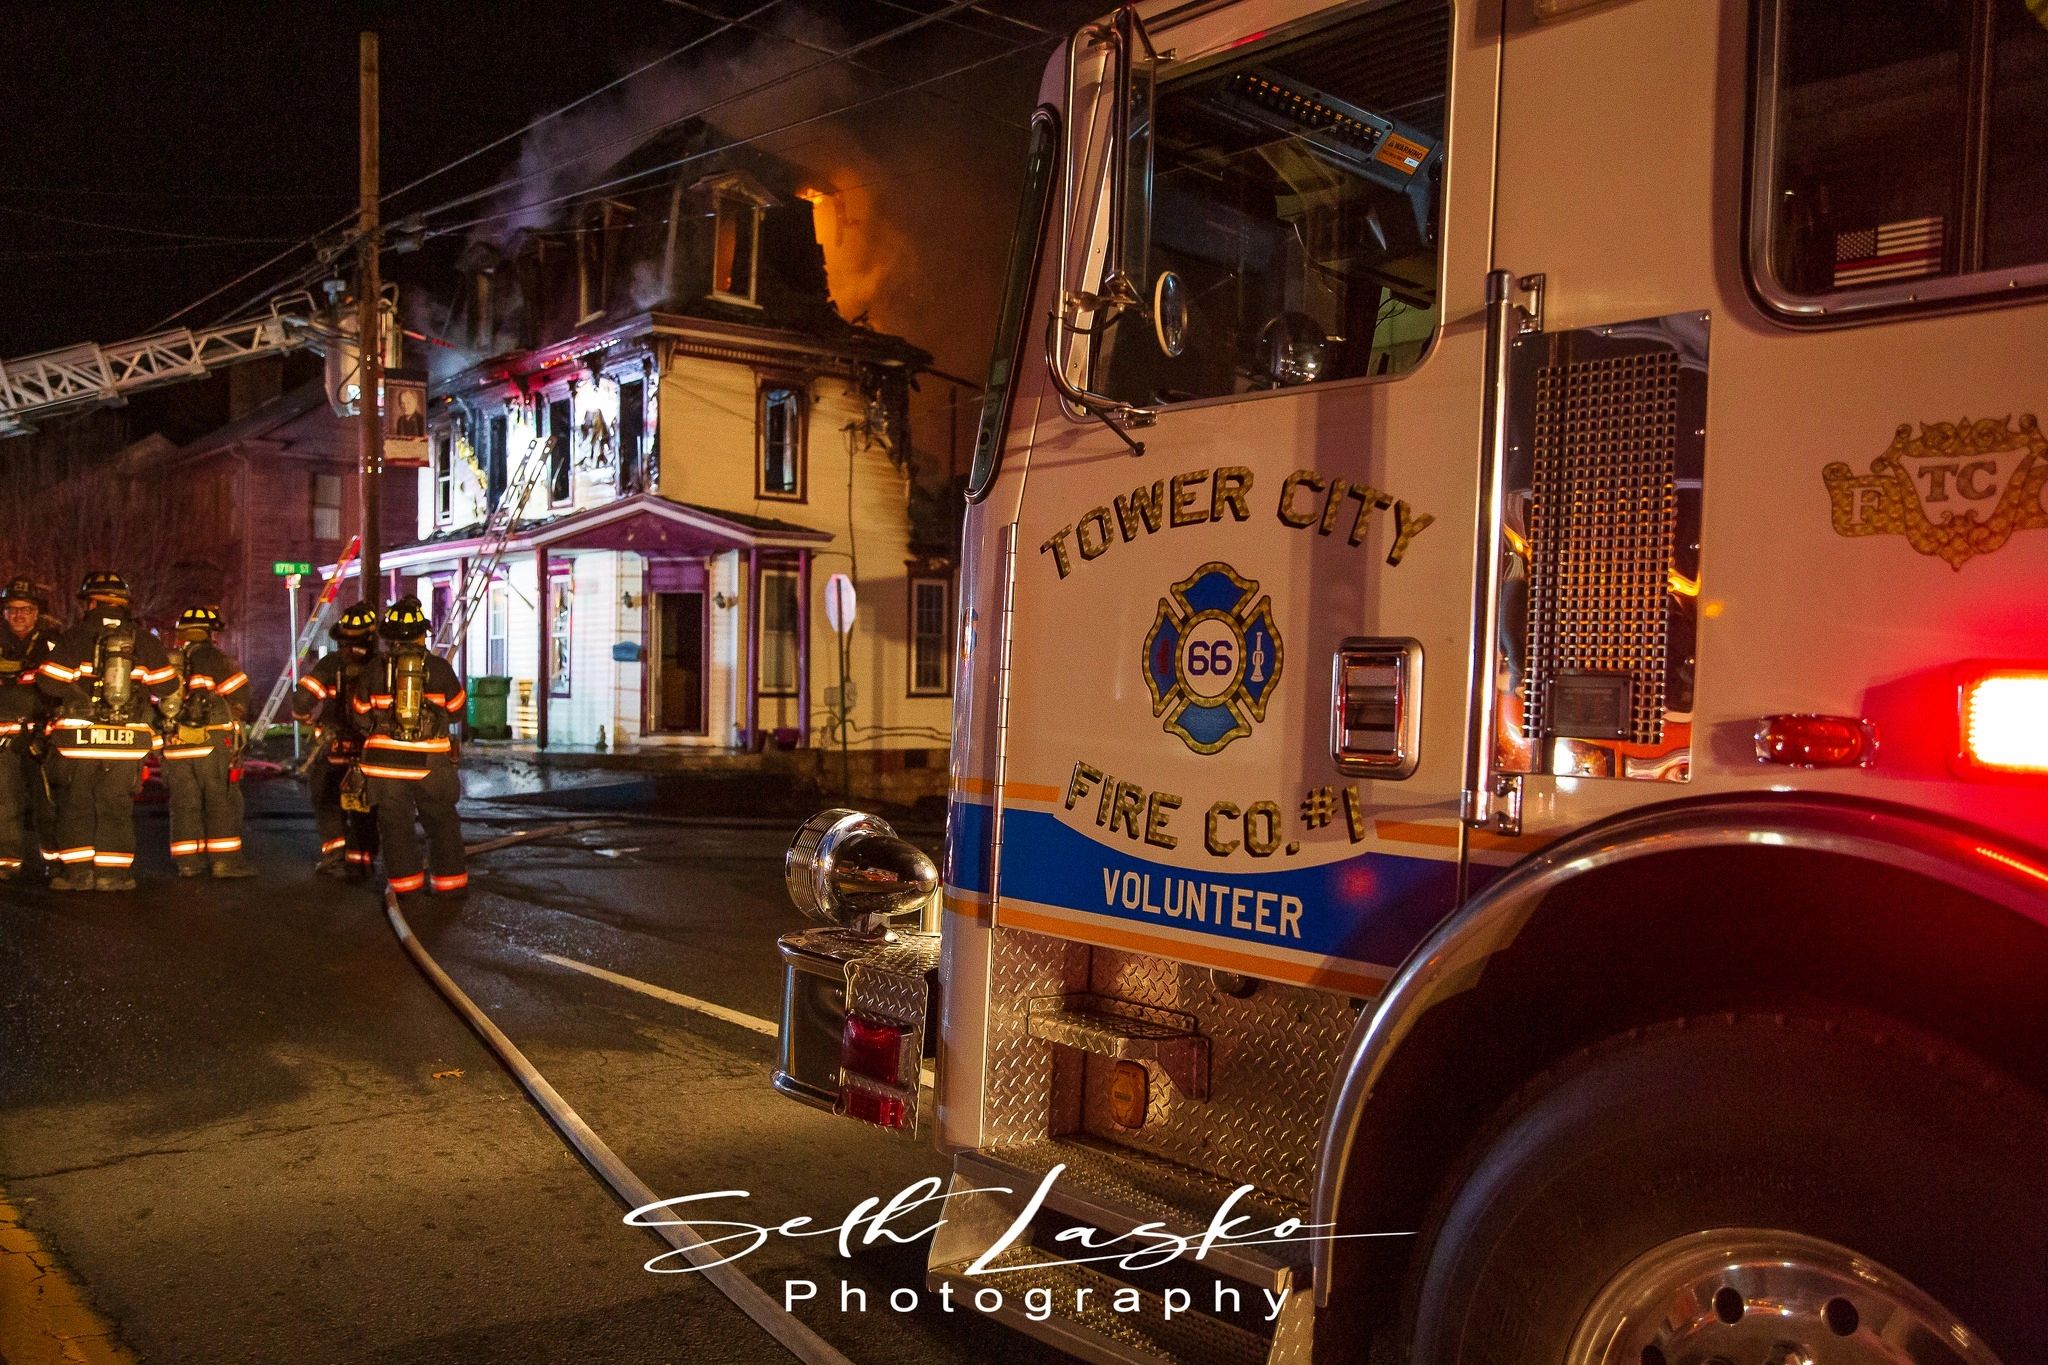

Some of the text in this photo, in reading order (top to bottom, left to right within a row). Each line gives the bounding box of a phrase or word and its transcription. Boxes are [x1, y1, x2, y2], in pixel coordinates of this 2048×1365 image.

[1918, 460, 1997, 502] TC
[1040, 466, 1437, 580] TOWER CITY
[1187, 640, 1233, 676] 66
[90, 728, 135, 745] MILLER
[1065, 760, 1365, 858] FIRE CO. #1
[1102, 866, 1305, 940] VOLUNTEER
